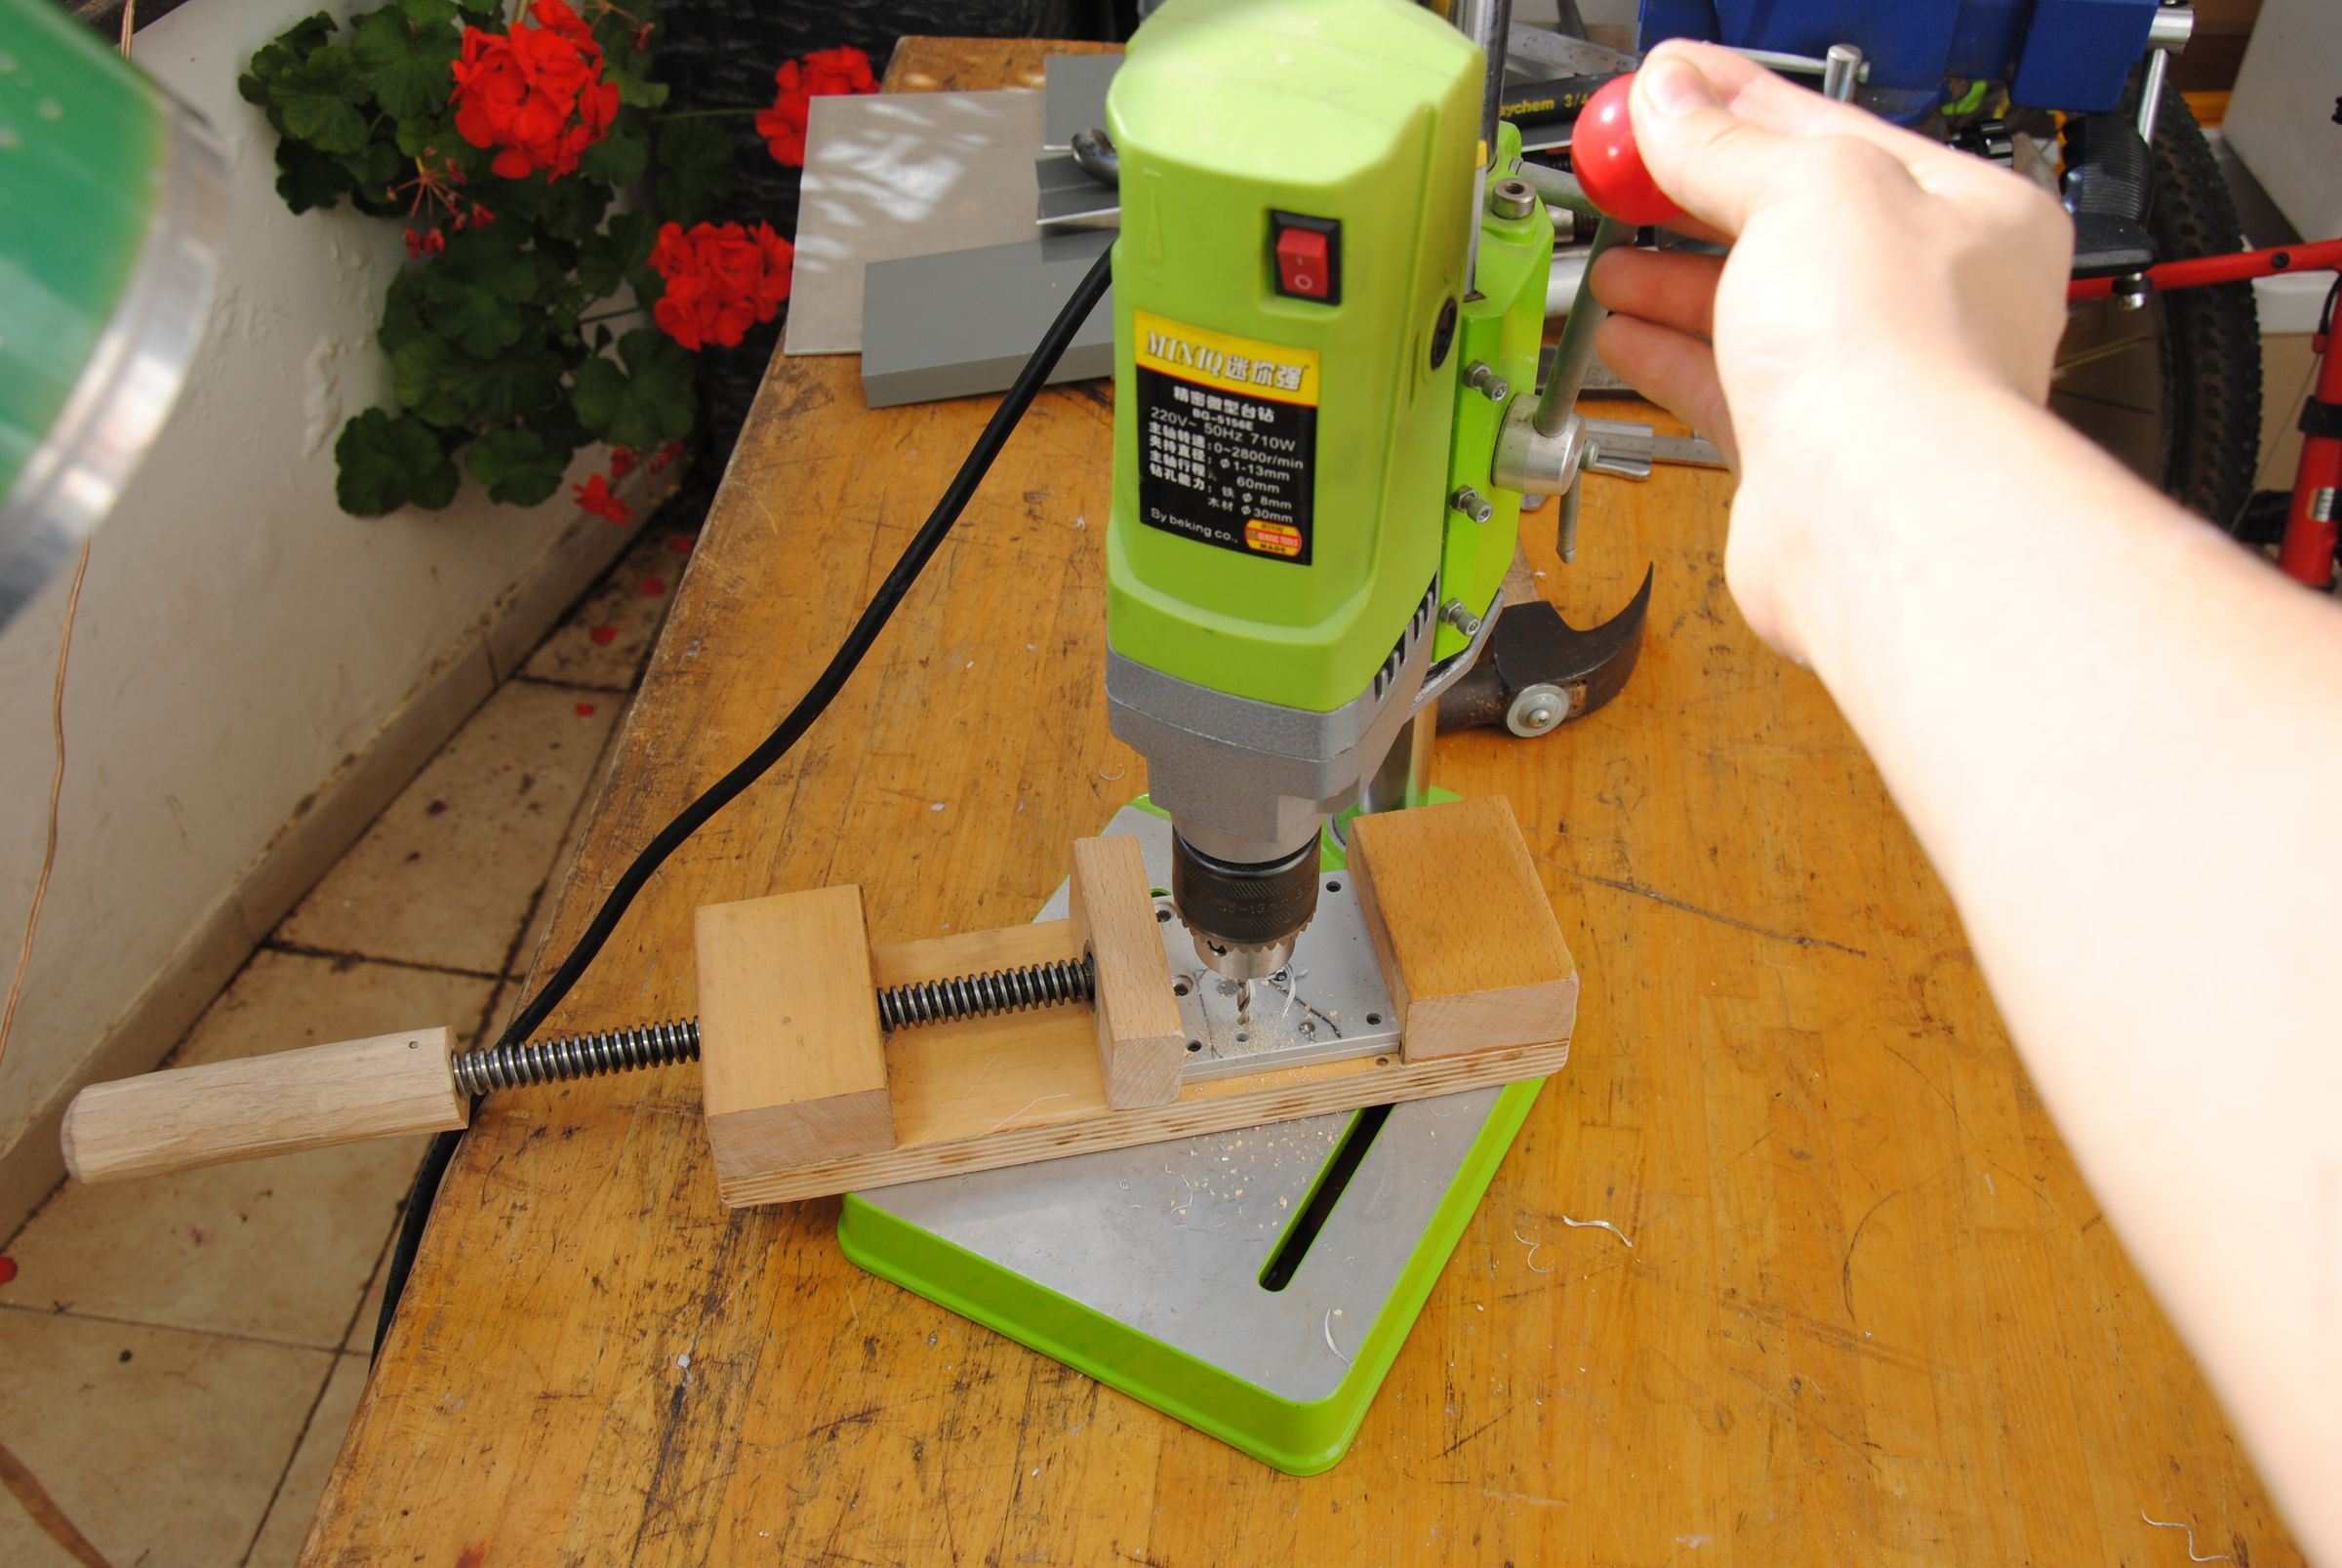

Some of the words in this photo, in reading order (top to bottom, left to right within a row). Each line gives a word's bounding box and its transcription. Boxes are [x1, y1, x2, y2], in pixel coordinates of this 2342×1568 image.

[1146, 331, 1224, 378] MINIQ
[1225, 354, 1304, 391] 迷你强
[1204, 422, 1243, 442] 50Hz
[1251, 433, 1296, 452] 710W
[1236, 476, 1279, 495] 60mm
[1151, 507, 1166, 523] By
[1169, 513, 1212, 538] beking
